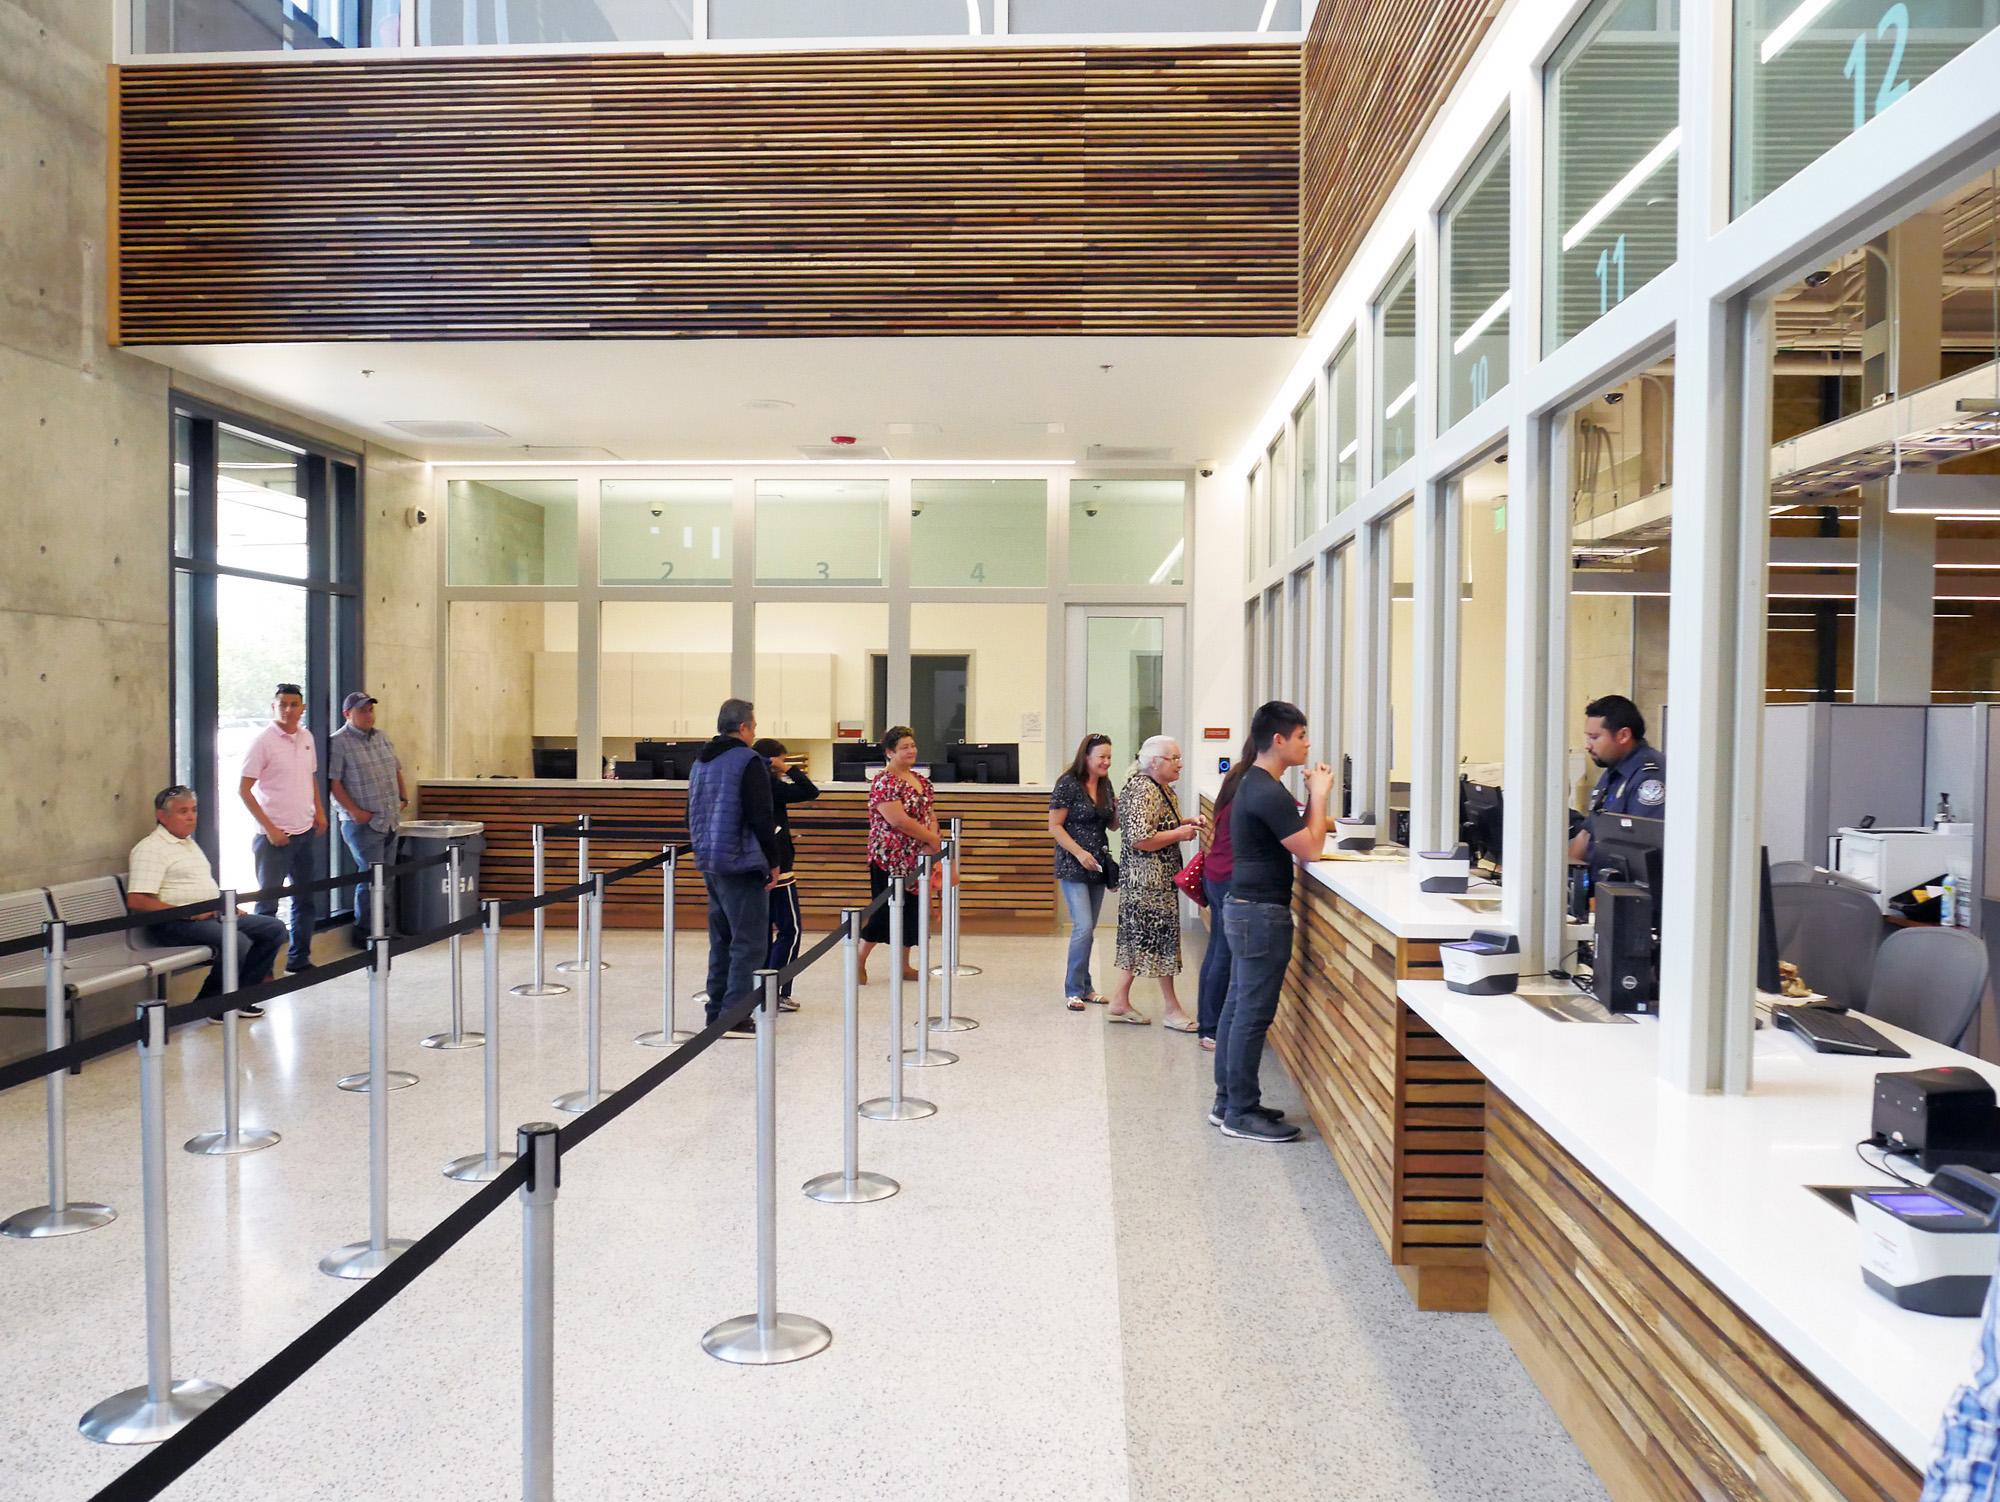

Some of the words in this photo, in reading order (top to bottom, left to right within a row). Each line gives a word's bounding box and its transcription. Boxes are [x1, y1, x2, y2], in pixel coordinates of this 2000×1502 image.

[1843, 3, 1910, 131] 12
[1595, 233, 1625, 316] 11
[1470, 355, 1489, 410] 10
[661, 561, 674, 580] 2
[816, 562, 830, 579] 3
[970, 562, 986, 583] 4
